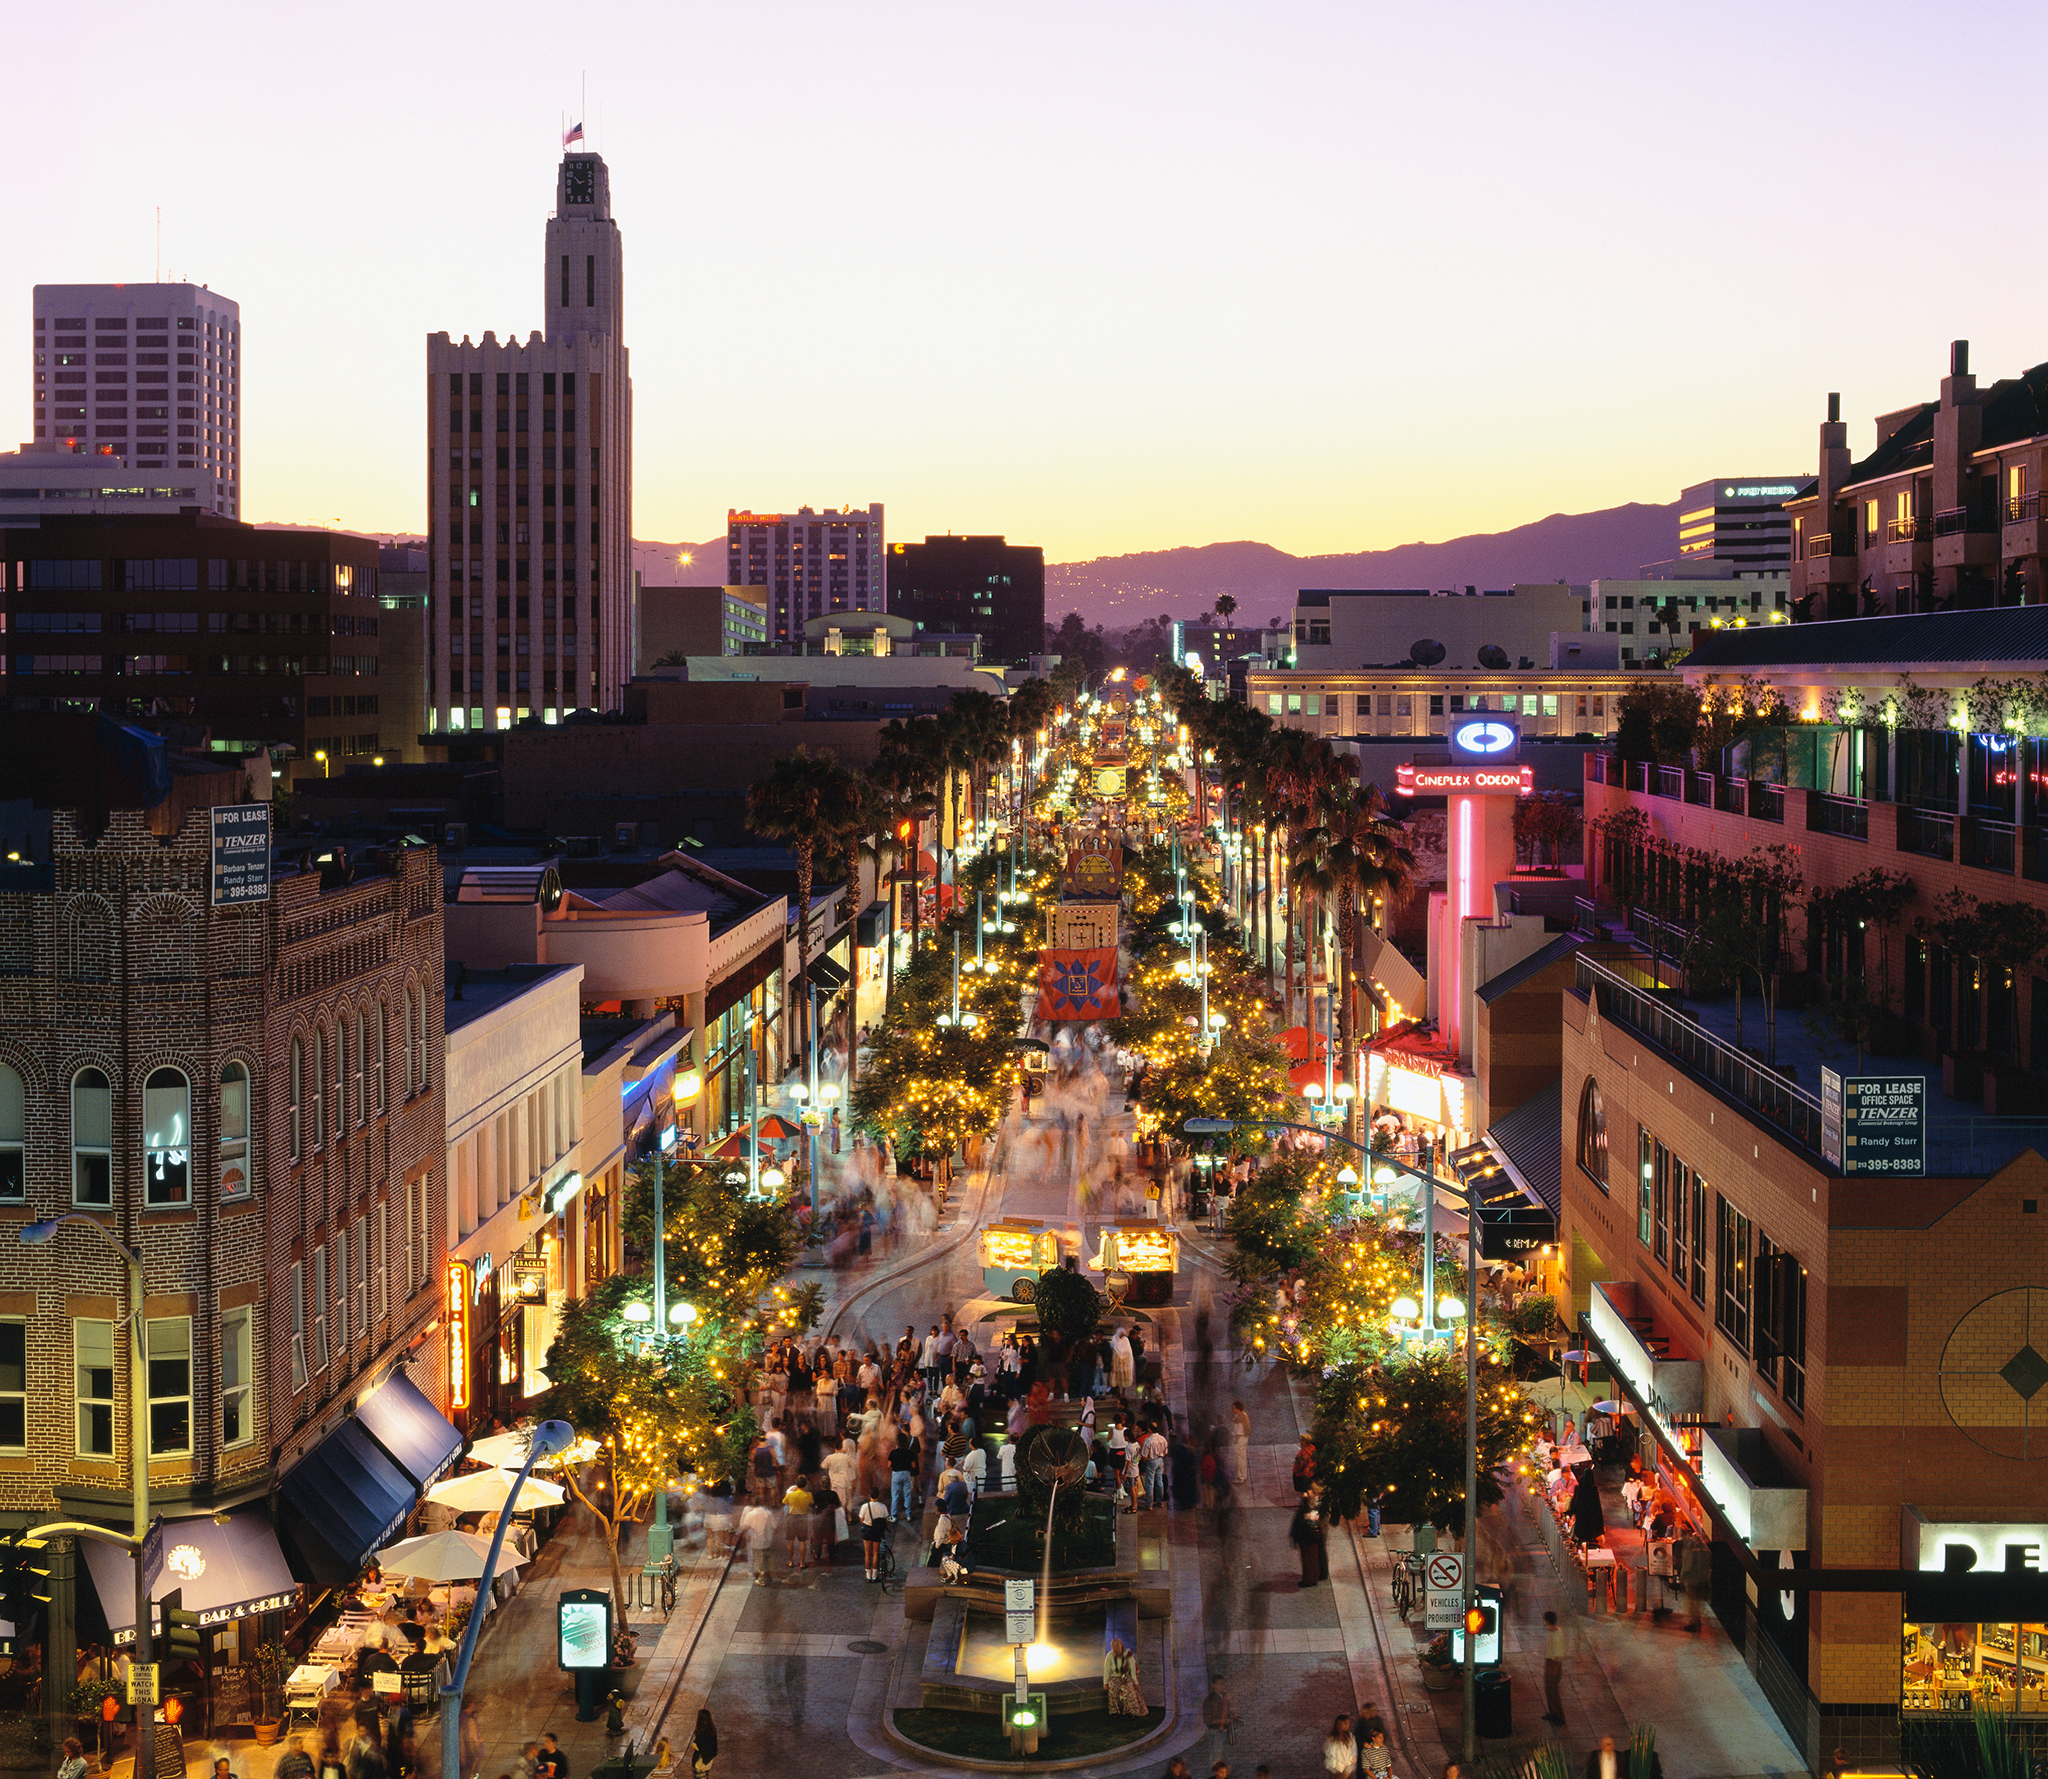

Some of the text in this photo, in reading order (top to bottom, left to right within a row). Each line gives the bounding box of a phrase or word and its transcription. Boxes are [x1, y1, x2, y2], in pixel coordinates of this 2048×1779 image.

[1415, 773, 1520, 786] CINEPLEX ODEON
[222, 810, 267, 823] FOR LEASE
[225, 833, 266, 847] TENZER
[223, 863, 265, 873] Barbara Tenzer
[223, 874, 264, 885] Randy Starr
[230, 883, 267, 898] 395-8383
[1858, 1083, 1922, 1094] FOR LEASE
[1861, 1095, 1914, 1106] OFFICE SPACE
[1860, 1107, 1919, 1119] TENZER
[1860, 1136, 1918, 1147] Randy Starr
[1867, 1159, 1921, 1170] 395-8383
[1430, 1598, 1459, 1608] VEHICLES
[200, 1594, 292, 1625] BAR & GRILL
[1427, 1614, 1461, 1623] PROHIBITED
[583, 1629, 601, 1641] Third
[583, 1636, 603, 1647] Street
[567, 1642, 605, 1657] Promenade
[135, 1688, 151, 1696] THIS
